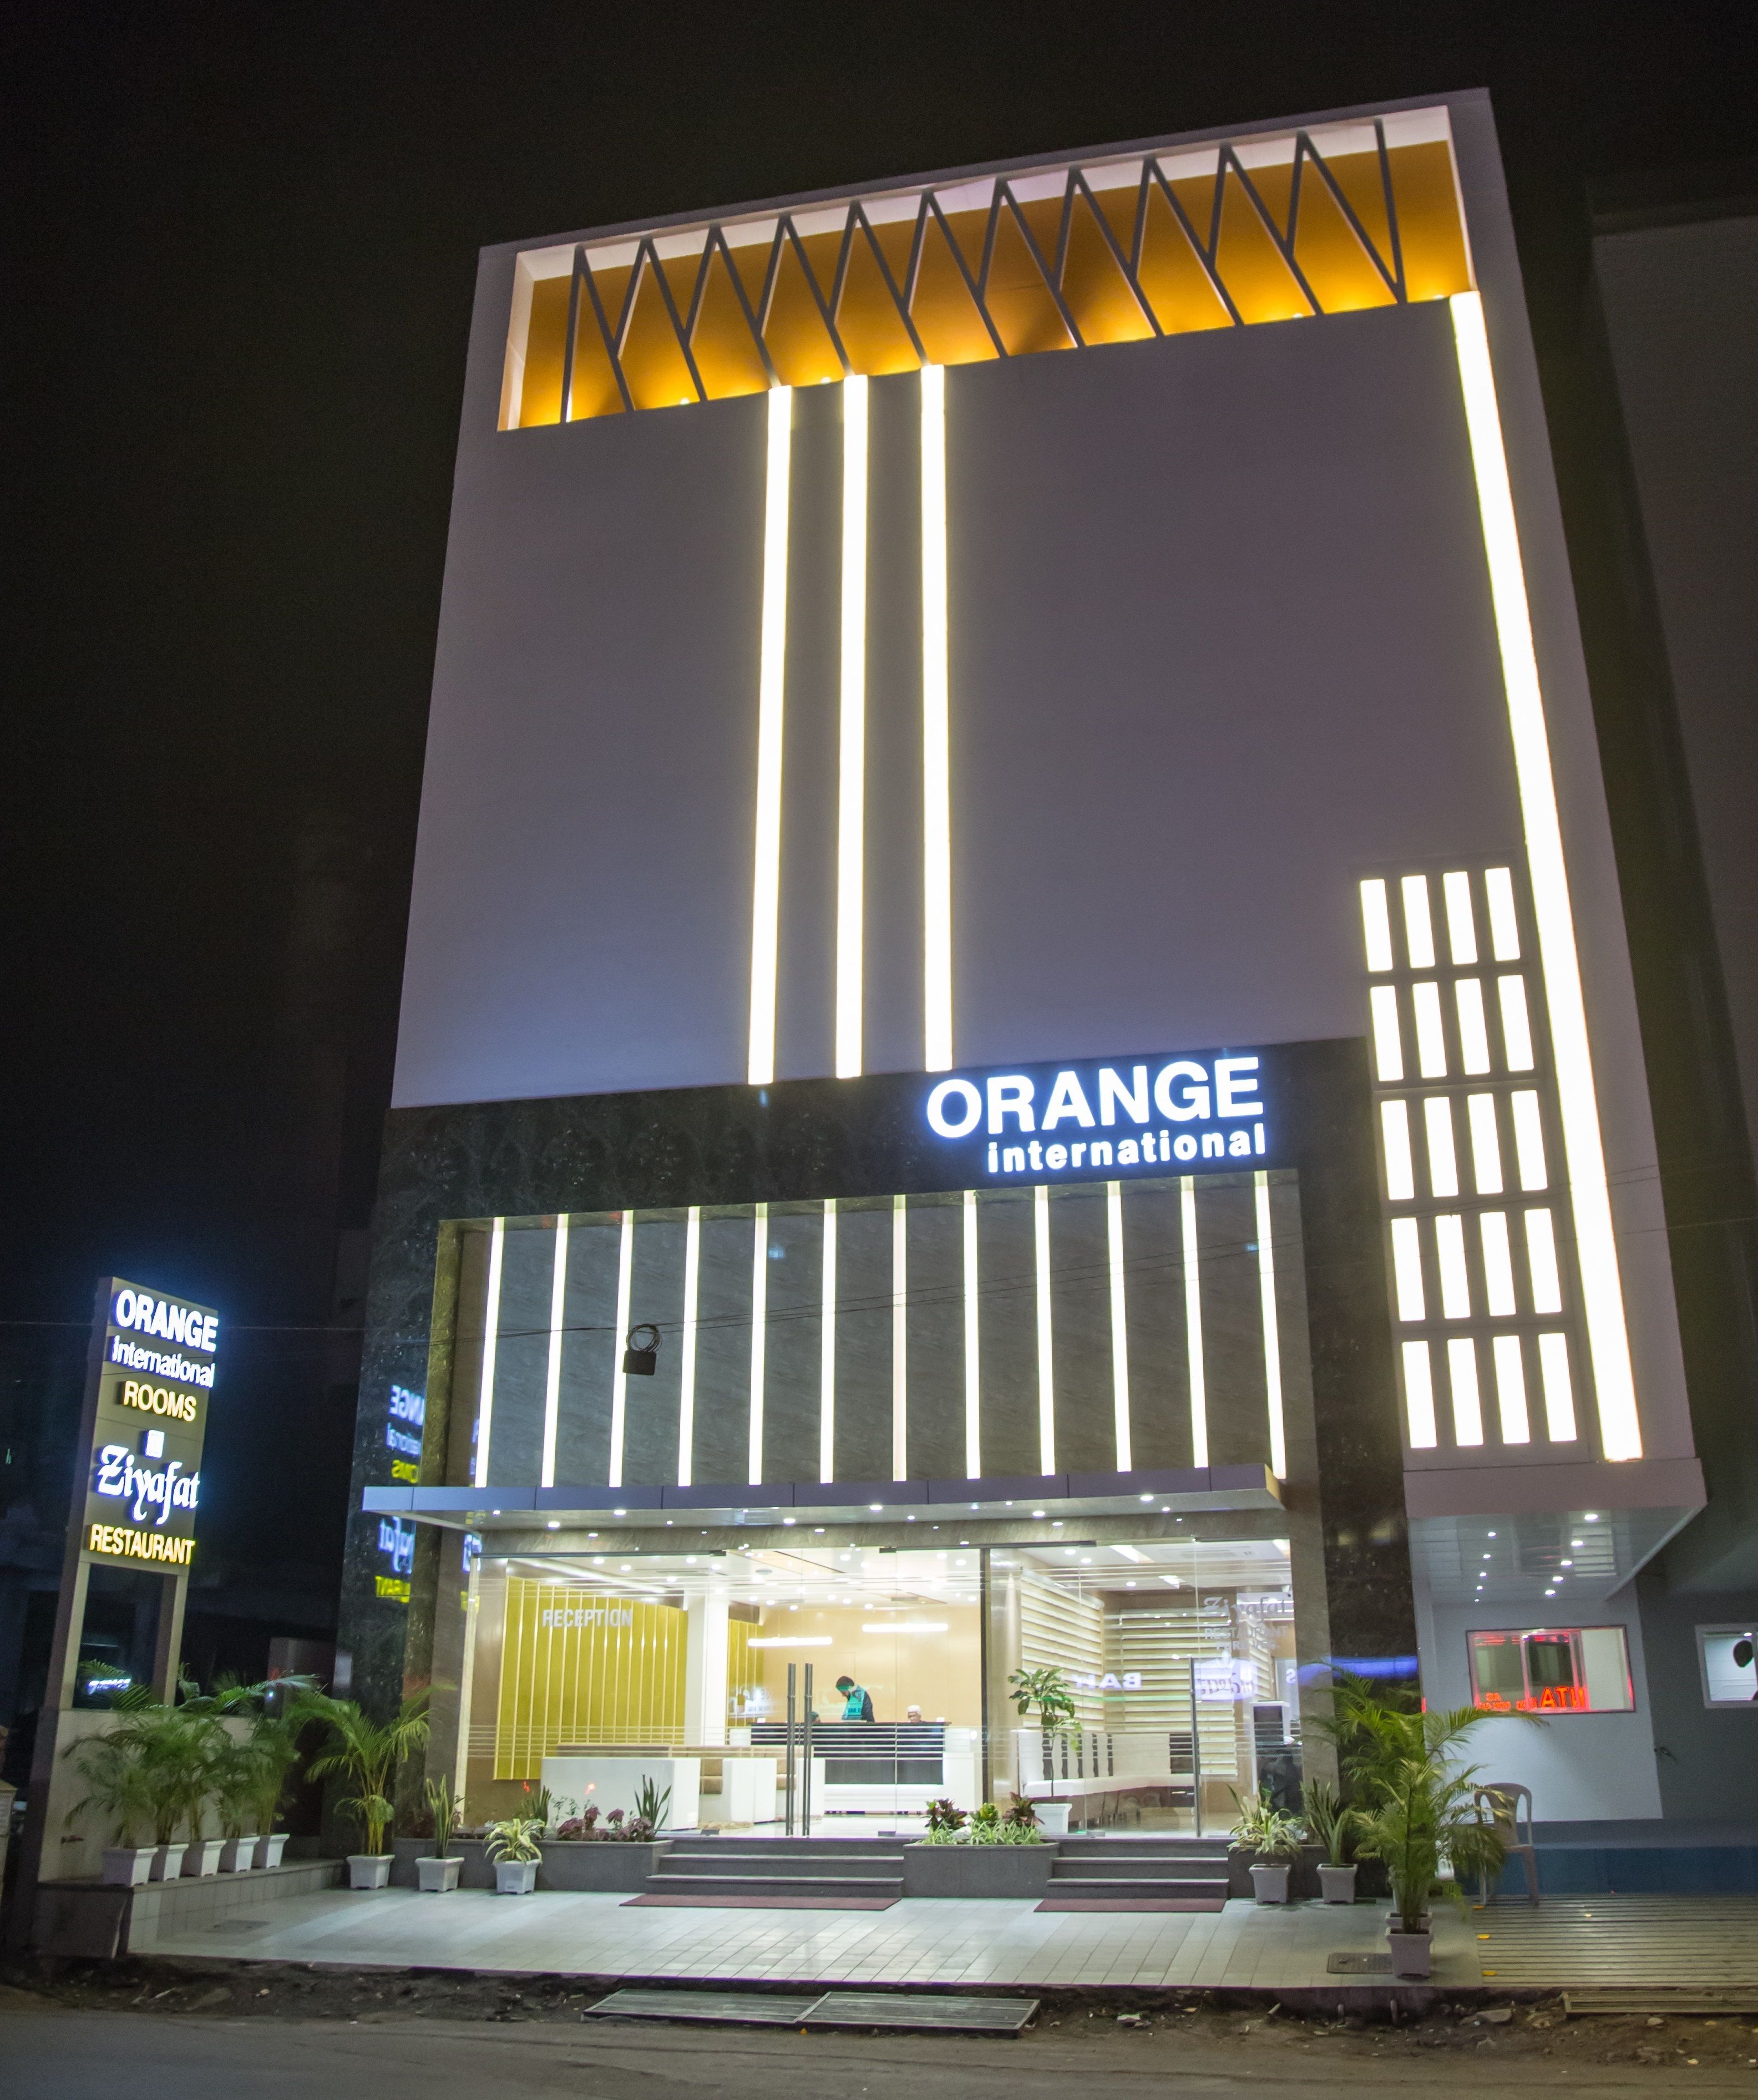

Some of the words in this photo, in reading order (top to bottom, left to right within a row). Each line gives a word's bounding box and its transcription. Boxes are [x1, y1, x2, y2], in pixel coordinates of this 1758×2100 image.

[926, 1056, 1264, 1139] ORANGE
[987, 1122, 1266, 1173] international
[115, 1289, 219, 1353] ORANGE
[123, 1380, 197, 1423] ROOMS
[97, 1444, 201, 1526] Ziyafat
[89, 1524, 196, 1565] RESTAURANT
[542, 1608, 633, 1628] RECEPTION
[1203, 1596, 1286, 1625] Ziyafat
